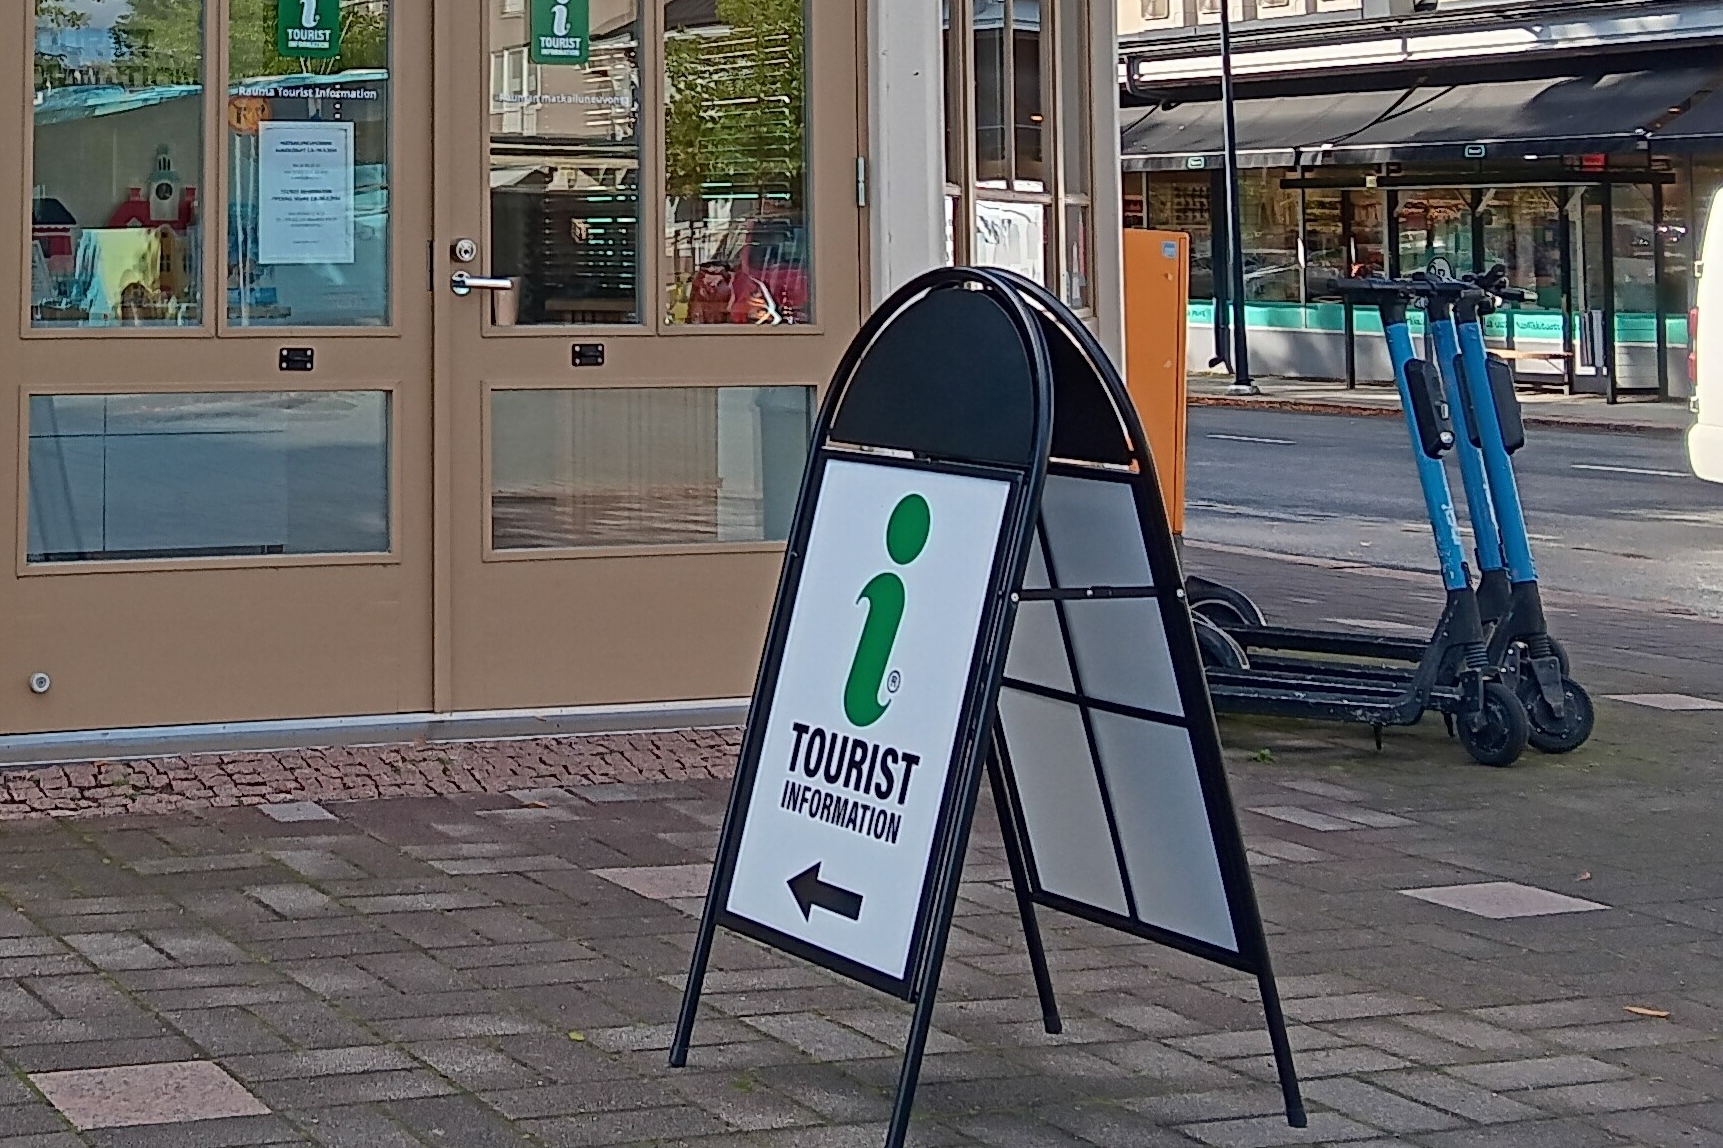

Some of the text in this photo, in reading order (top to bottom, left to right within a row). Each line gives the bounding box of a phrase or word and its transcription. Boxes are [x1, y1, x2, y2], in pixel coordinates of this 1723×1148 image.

[286, 28, 331, 42] TOURIST
[539, 36, 582, 49] TOURIST
[238, 86, 377, 100] Rauma Tourist Information
[788, 721, 921, 805] TOURIST
[780, 780, 902, 844] INFORMATION
